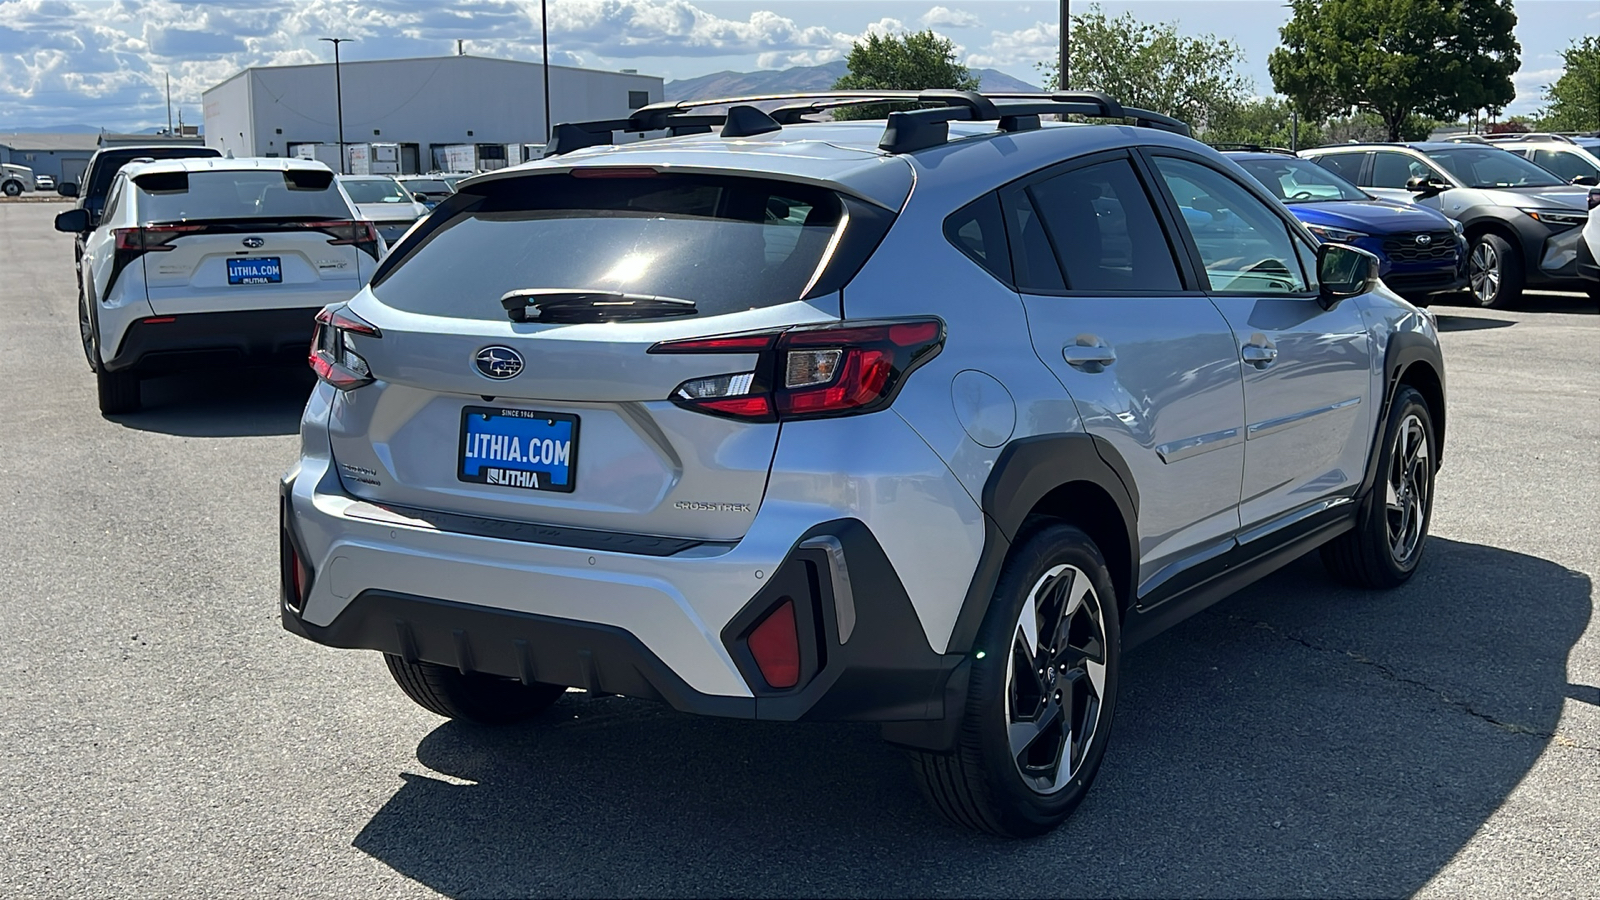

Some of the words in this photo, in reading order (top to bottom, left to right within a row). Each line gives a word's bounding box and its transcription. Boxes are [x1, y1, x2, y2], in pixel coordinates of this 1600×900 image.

[229, 265, 280, 277] LITHIA.COM
[501, 409, 519, 418] SINCE
[520, 410, 534, 418] 1946
[465, 432, 571, 467] LITHIA.COM
[498, 469, 539, 488] LITHIA
[673, 501, 751, 512] CROSSTREK
